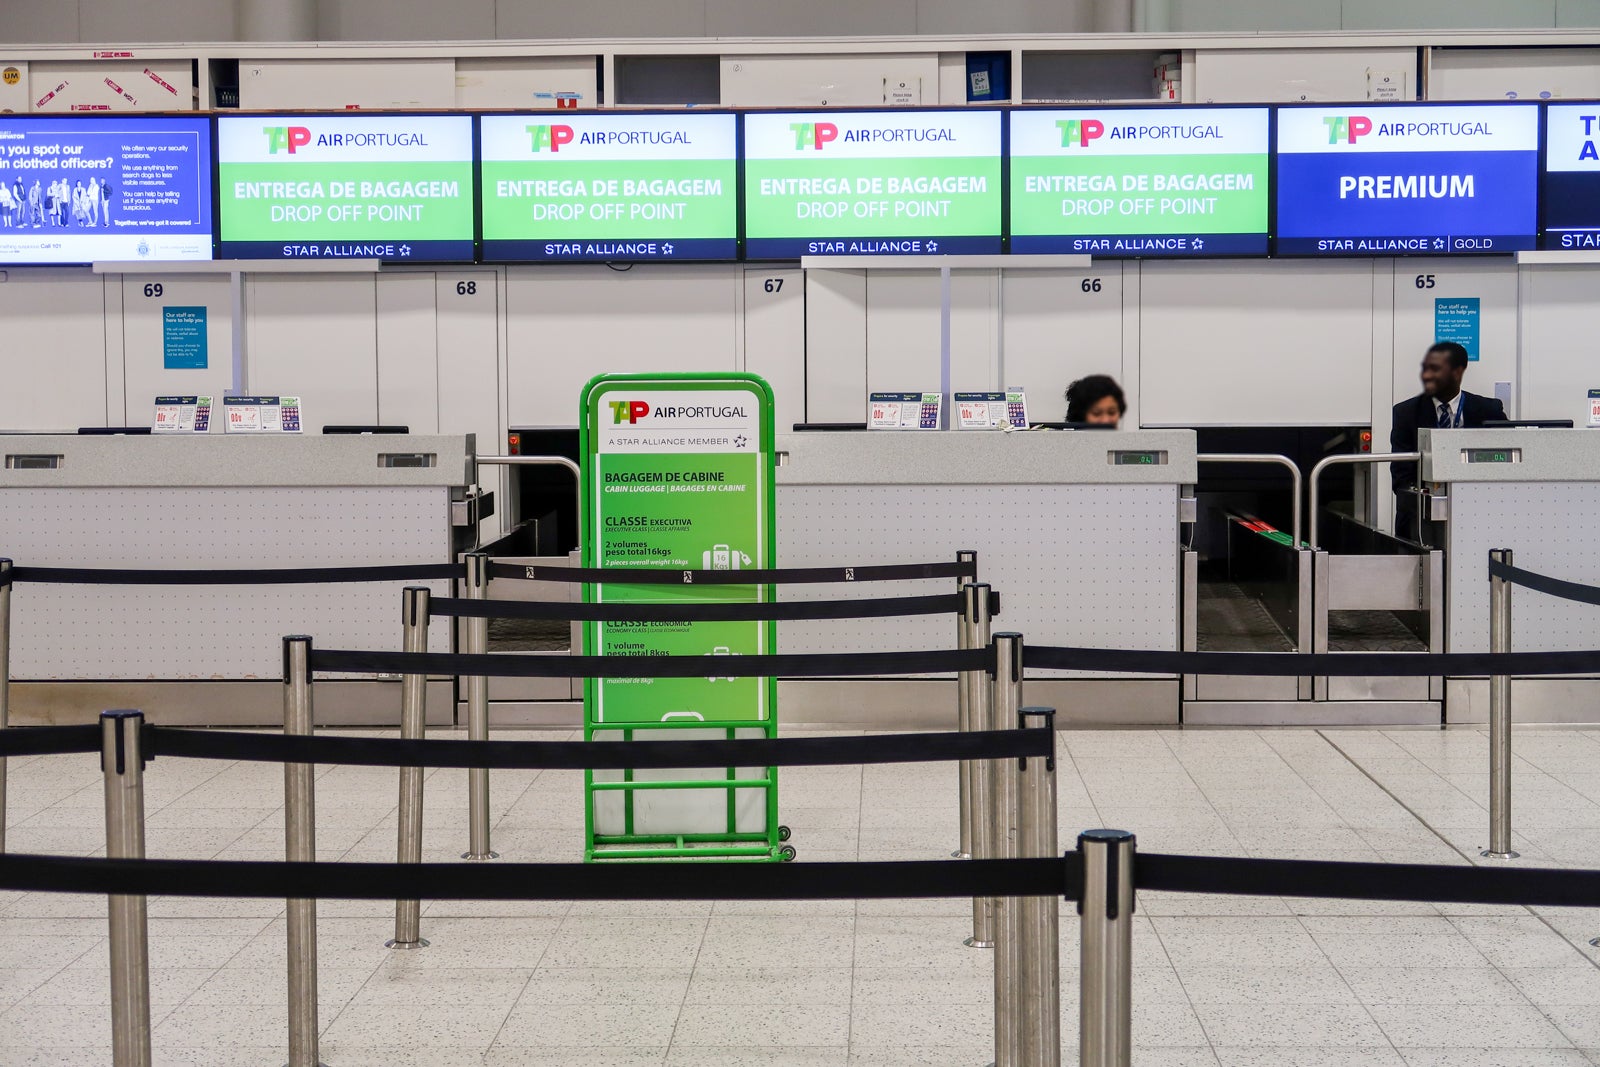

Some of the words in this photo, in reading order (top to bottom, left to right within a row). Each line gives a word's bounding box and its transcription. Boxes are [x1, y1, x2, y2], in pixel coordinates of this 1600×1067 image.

[789, 123, 838, 150] TAP
[1056, 120, 1104, 147] TAP
[1323, 116, 1372, 144] TAP
[265, 127, 311, 154] TAP
[527, 125, 574, 152] TAP
[8, 146, 30, 157] you
[33, 144, 60, 157] spot
[63, 146, 83, 155] our
[13, 158, 58, 168] clothed
[61, 157, 114, 169] officers?
[235, 182, 325, 199] ENTREGA
[330, 182, 356, 198] DE
[361, 181, 459, 198] BAGAGEM
[497, 180, 587, 197] ENTREGA
[592, 180, 618, 197] DE
[623, 179, 722, 196] BAGAGEM
[760, 177, 852, 195] ENTREGA
[856, 177, 883, 195] DE
[887, 176, 987, 194] BAGAGEM
[1025, 175, 1118, 192] ENTREGA
[1122, 174, 1148, 192] DE
[1153, 174, 1254, 191] BAGAGEM
[1340, 175, 1475, 199] PREMIUM
[271, 205, 322, 222] DROP
[327, 205, 362, 222] OFF
[368, 205, 424, 221] POINT
[533, 204, 585, 220] DROP
[590, 203, 625, 220] OFF
[630, 203, 687, 220] POINT
[797, 202, 849, 218] DROP
[853, 201, 889, 218] OFF
[895, 200, 951, 218] POINT
[1062, 199, 1114, 216] DROP
[1120, 199, 1155, 215] OFF
[1160, 198, 1218, 215] POINT
[283, 246, 318, 256] STAR
[323, 245, 393, 255] ALLIANCE
[545, 244, 581, 254] STAR
[586, 244, 656, 254] ALLIANCE
[808, 242, 846, 252] STAR
[849, 241, 920, 251] ALLIANCE
[1073, 240, 1109, 250] STAR
[1114, 239, 1186, 249] ALLIANCE
[1318, 239, 1353, 250] STAR
[1358, 239, 1427, 249] ALLIANCE
[1455, 238, 1492, 248] GOLD
[456, 281, 476, 295] 68
[764, 279, 783, 292] 67
[1081, 279, 1101, 292] 66
[1415, 274, 1435, 288] 65
[144, 283, 163, 297] 69
[609, 401, 649, 424] TAP
[605, 473, 662, 482] BAGAGEM
[665, 472, 680, 482] DE
[683, 472, 725, 481] CABINE
[604, 485, 628, 493] CABIN
[718, 484, 746, 492] CABINE
[605, 517, 648, 526] CLASSE
[605, 549, 626, 557] peso
[610, 559, 629, 567] pieces
